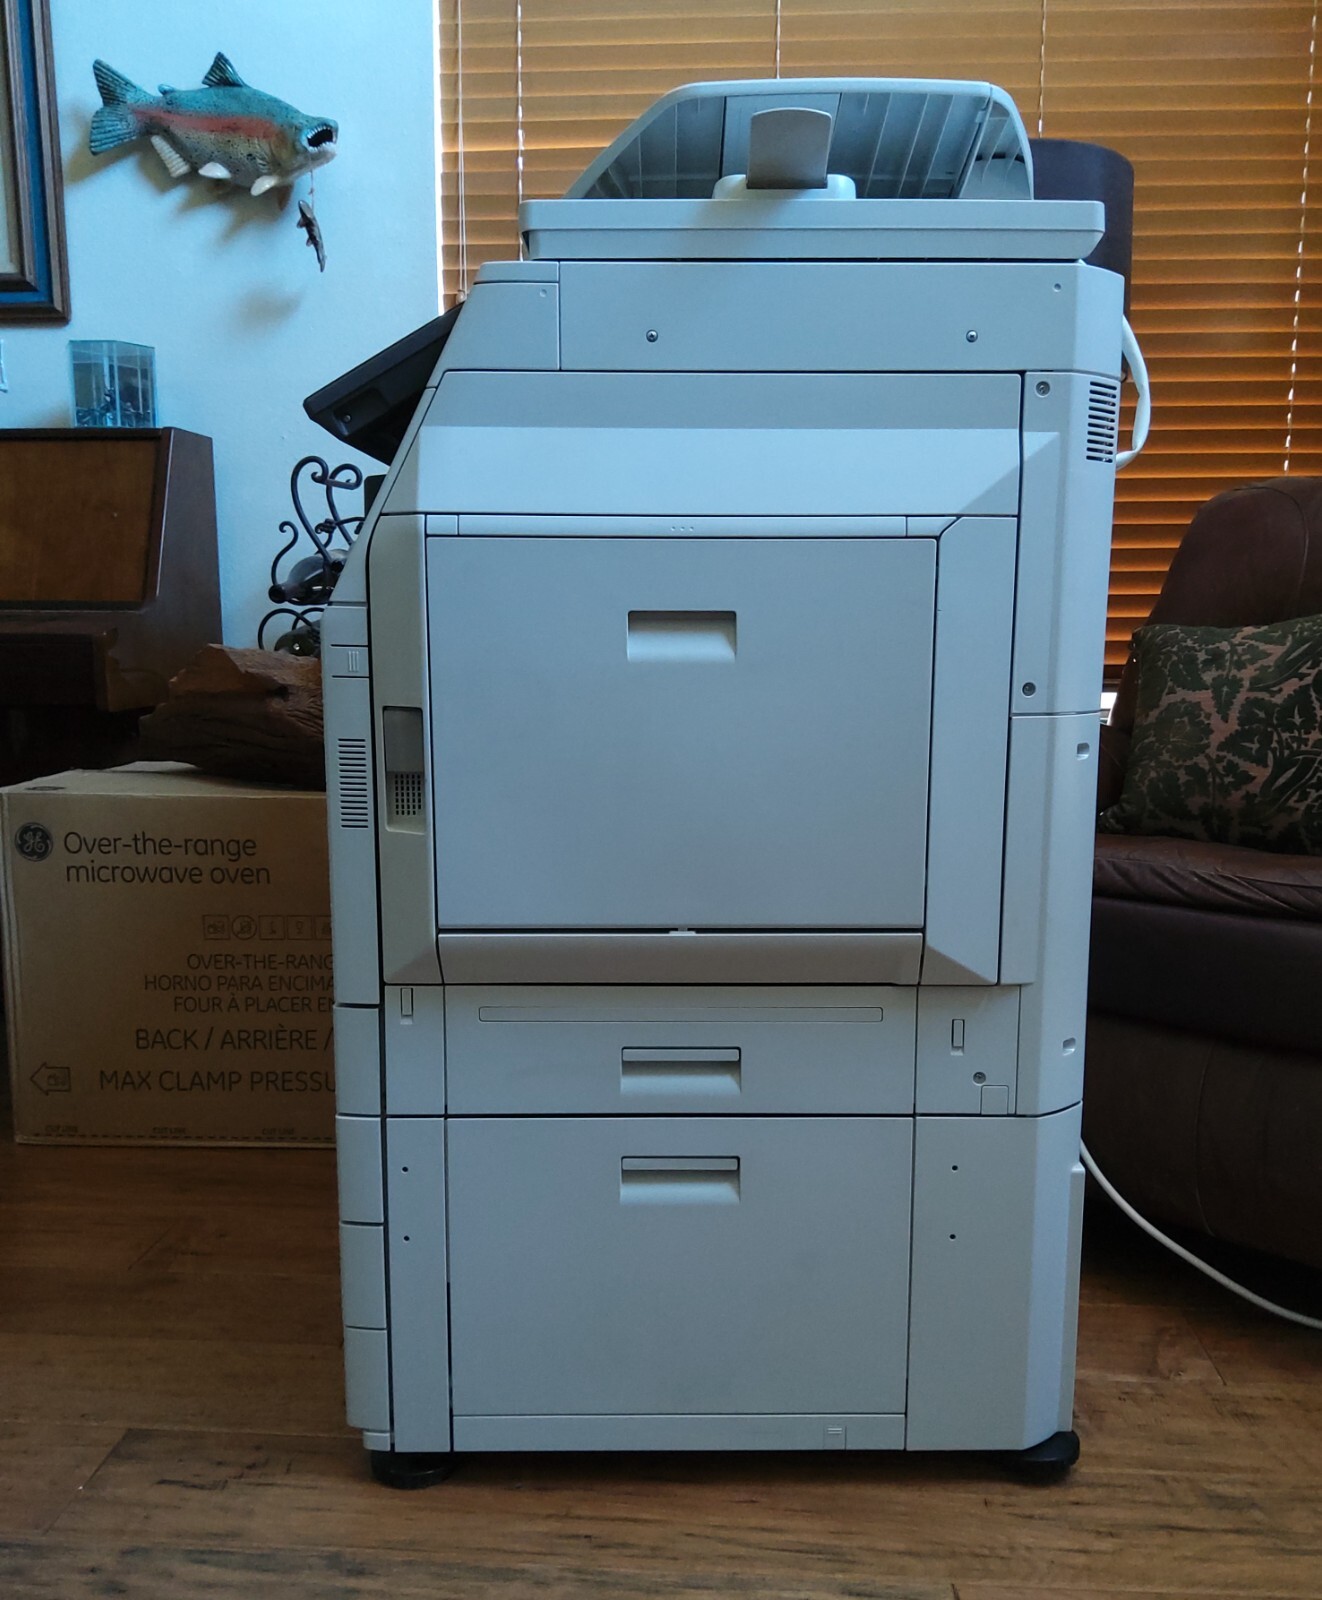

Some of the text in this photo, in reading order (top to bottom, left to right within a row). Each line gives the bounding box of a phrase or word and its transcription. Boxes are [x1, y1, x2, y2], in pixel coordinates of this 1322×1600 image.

[63, 831, 257, 861] Over-the-range
[66, 859, 271, 884] microwave oven
[187, 953, 333, 970] OVER-THE-RANG
[144, 974, 334, 991] HORNO PARA ENCIMA
[174, 996, 223, 1012] FOUR
[227, 992, 240, 1012] À
[245, 996, 312, 1012] PLACER
[135, 1028, 198, 1050] BACK
[204, 1026, 214, 1051] /
[220, 1023, 318, 1050] ARRIÈRE
[100, 1070, 335, 1093] MAX CLAMP PRESSU
